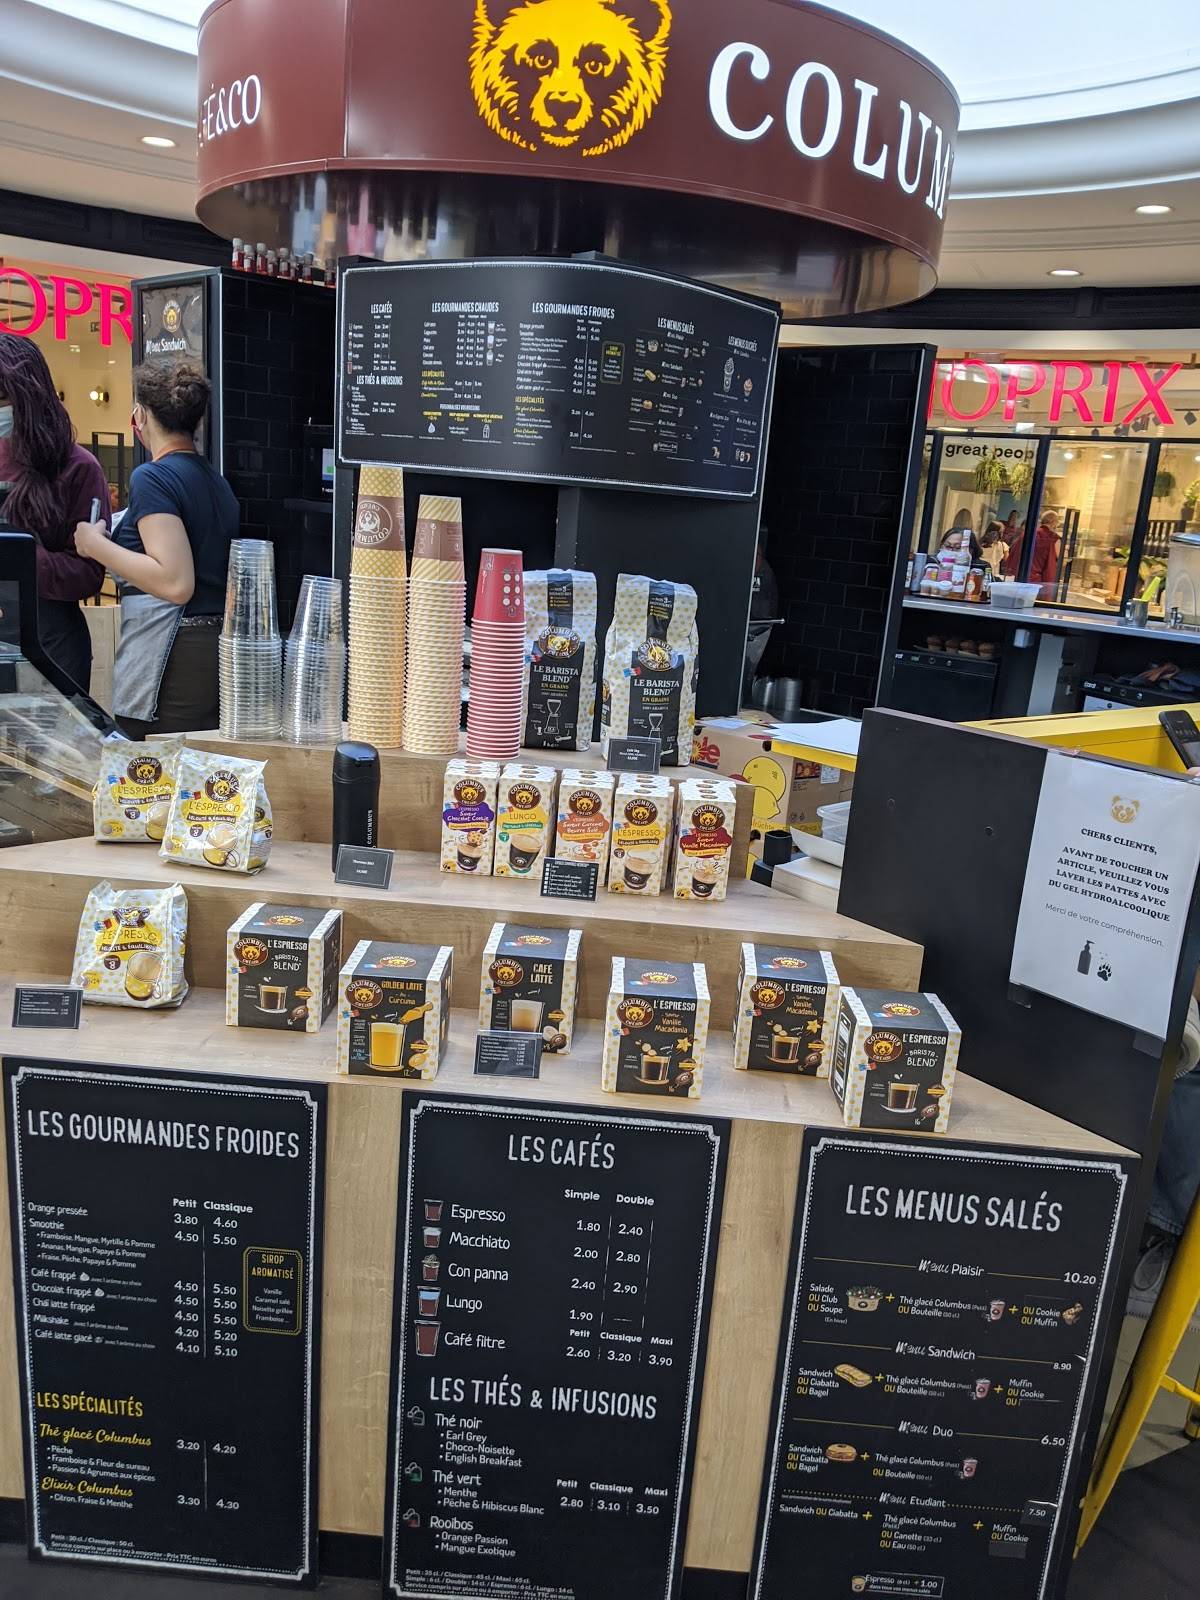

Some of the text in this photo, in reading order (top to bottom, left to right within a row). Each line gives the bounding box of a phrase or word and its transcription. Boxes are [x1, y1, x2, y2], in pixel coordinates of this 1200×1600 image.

[532, 302, 615, 319] LES GOURMANDES FROIDES
[161, 338, 186, 351] Sandwich
[945, 442, 988, 459] great
[545, 667, 579, 675] BARISTA
[634, 679, 645, 687] LE
[626, 799, 655, 812] COLUMBUS
[694, 805, 723, 817] COLUMBUS
[617, 829, 660, 837] L'ESPRESSO
[1081, 828, 1158, 855] CHERS CLIENTS,
[1062, 846, 1169, 881] AVANT DE TOUCHER UN
[1057, 857, 1170, 894] ARTICLE, VEUILLEZ VOUS
[1056, 869, 1166, 907] LAVER LES PATTES AVEC
[1048, 879, 1170, 922] DU GEL HYDROALCOOLIQUE
[1045, 902, 1166, 947] Merci de votre compréhension.
[268, 940, 308, 951] L'ESPRESSO
[109, 961, 115, 969] 8
[273, 962, 300, 971] BLEND
[492, 959, 521, 972] COLUMBUS
[348, 980, 382, 993] COLUMBUS
[382, 981, 423, 990] GOLDEN LATTE
[531, 974, 553, 984] LATTE
[785, 983, 826, 995] L'ESPRESSO
[389, 996, 416, 1005] Curcuma
[653, 1000, 696, 1012] L'ESPRESSO
[793, 1000, 812, 1008] Vanille
[785, 1007, 818, 1016] Macadamia
[654, 1024, 688, 1034] Macadamia
[662, 1018, 682, 1026] Vanille
[867, 1032, 900, 1046] COLUMBUS
[903, 1034, 946, 1045] L'ESPRESSO
[909, 1049, 935, 1057] BARISTA
[907, 1057, 936, 1067] BLEND
[27, 1109, 300, 1158] LES GOURMANDES FROIDES
[508, 1133, 616, 1169] LES CAFÉS
[564, 1188, 654, 1206] Simple Double
[173, 1198, 253, 1214] Petit Classique
[845, 1183, 1063, 1232] LES MENUS SALÉS
[28, 1202, 238, 1229] Orange pressée 3.80 4.60
[451, 1204, 643, 1236] Espresso 1.80 2.40
[29, 1218, 237, 1246] Smoothie 4.50 5.50
[449, 1232, 640, 1263] Macchiato 2.00 2.80
[261, 1254, 285, 1265] SIROP
[251, 1266, 294, 1280] AROMATISÉ
[448, 1263, 638, 1295] Con panna 2.40 2.90
[951, 1263, 984, 1278] Plaisir
[1063, 1271, 1097, 1285] 10.20
[810, 1282, 834, 1294] Salade
[899, 1294, 972, 1310] Thé glacé Columbus
[444, 1331, 672, 1366] Café filtre 2.60 3.20 3.90
[928, 1345, 976, 1361] Sandwich
[1053, 1361, 1072, 1372] 8.90
[36, 1390, 144, 1418] LES SPÉCIALITÉS
[429, 1373, 657, 1420] LES THÉS & INFUSIONS
[435, 1413, 483, 1429] Thé noir
[40, 1423, 236, 1454] Thé glacé Columbus 3.20 4.20
[932, 1425, 954, 1438] Duo
[1041, 1435, 1066, 1447] 6.50
[445, 1452, 522, 1468] English Breakfast
[42, 1477, 240, 1510] Elixir Columbus 3.30 4.30
[430, 1515, 474, 1531] Rooibos
